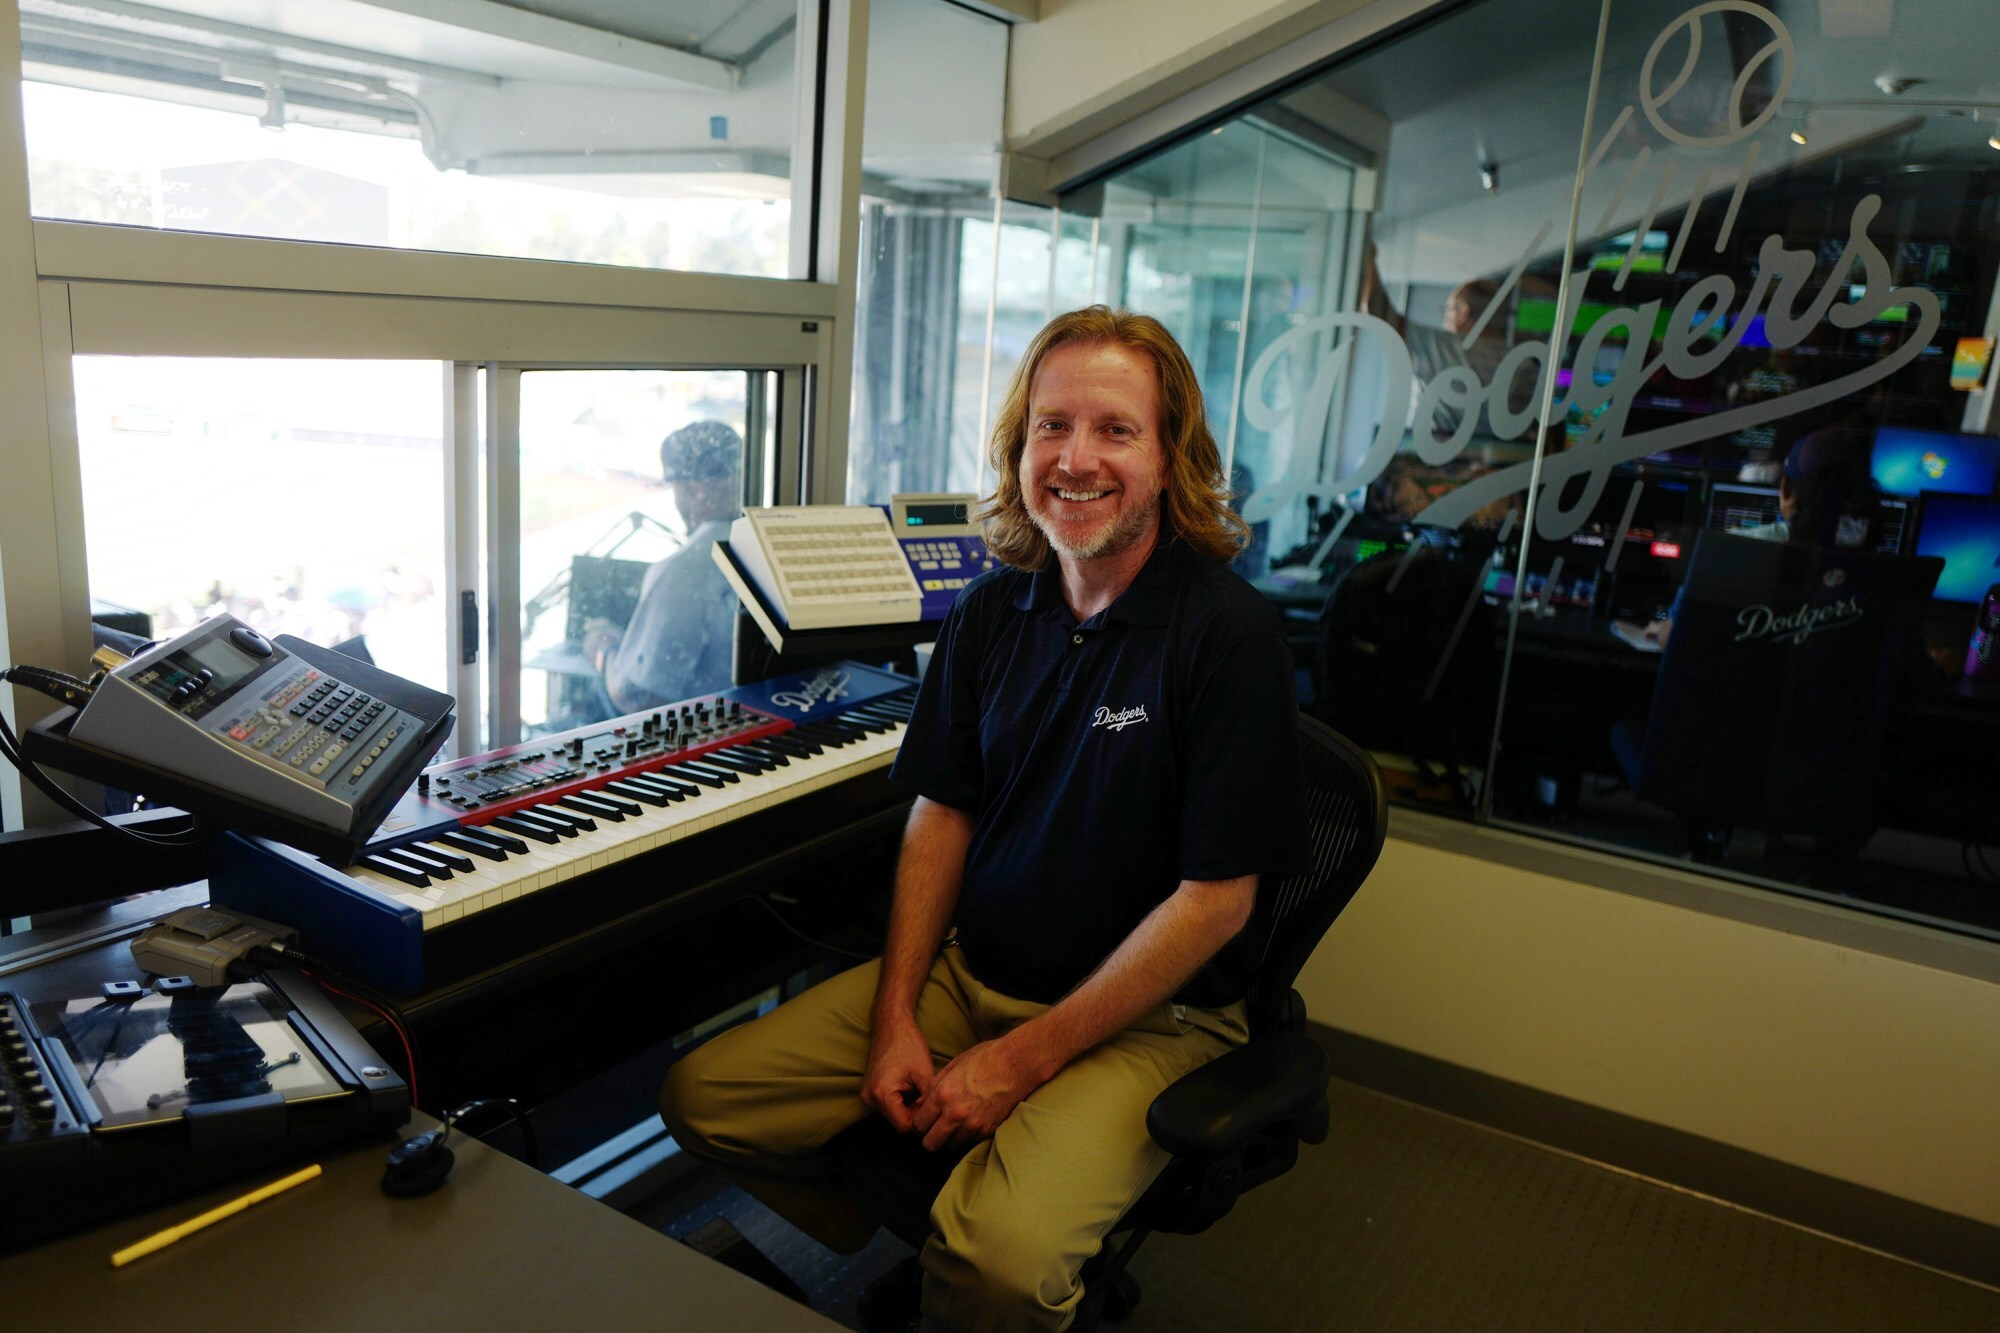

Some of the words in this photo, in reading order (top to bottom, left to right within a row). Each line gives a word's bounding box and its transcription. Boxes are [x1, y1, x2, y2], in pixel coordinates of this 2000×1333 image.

[1243, 195, 1941, 541] Dodgers
[1734, 595, 1863, 645] Dodgers
[1092, 704, 1147, 732] Dodgers
